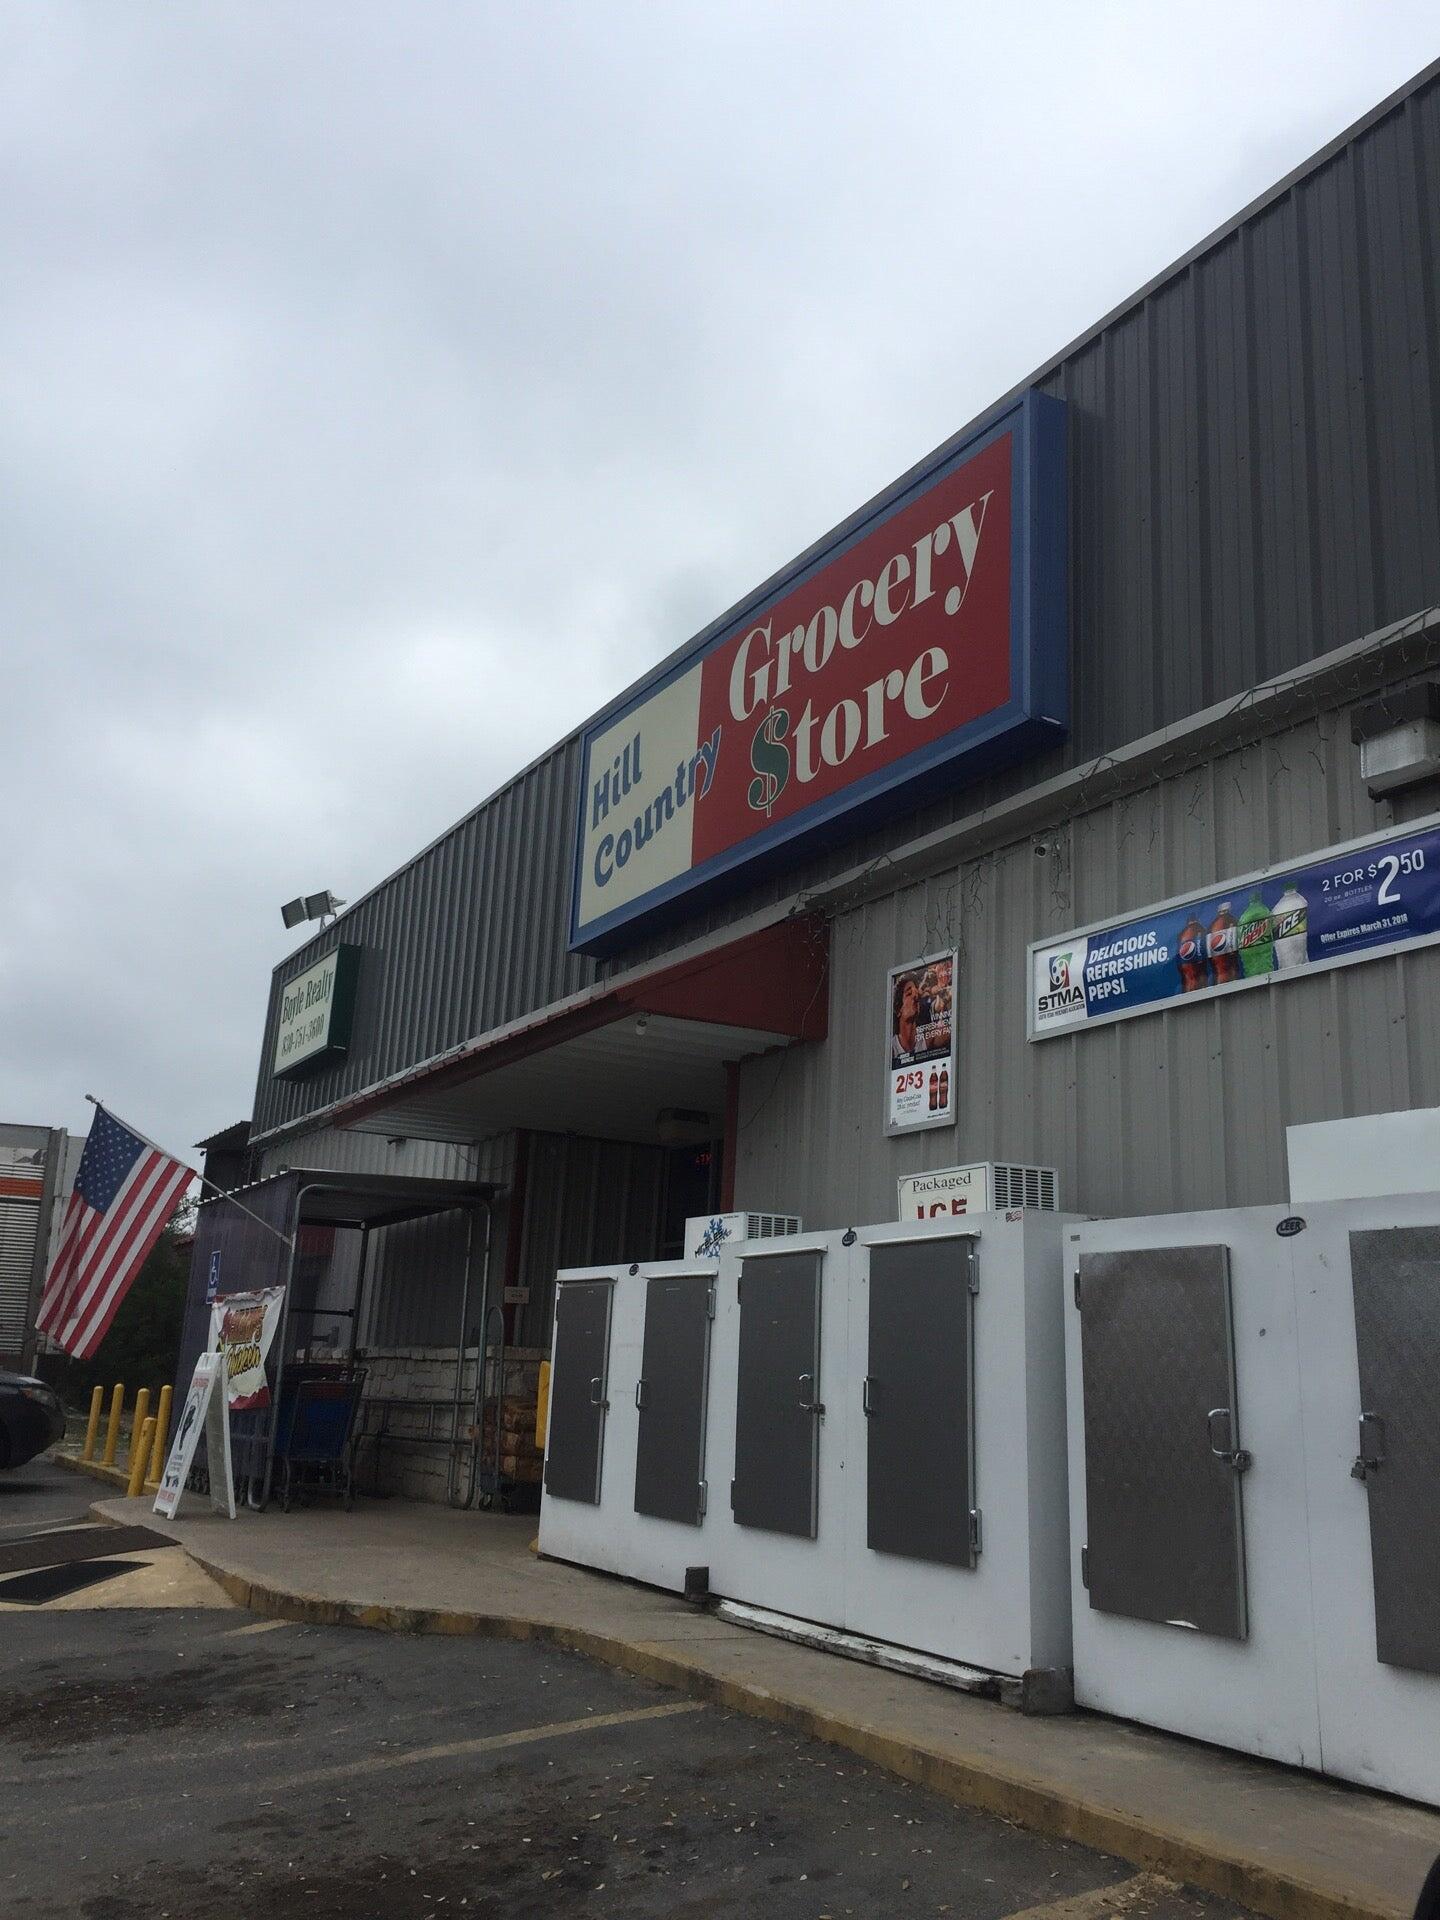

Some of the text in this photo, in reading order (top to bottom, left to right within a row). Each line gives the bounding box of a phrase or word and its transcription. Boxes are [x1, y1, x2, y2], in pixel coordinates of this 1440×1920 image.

[729, 490, 994, 721] Grocery
[592, 731, 642, 831] Hill
[594, 725, 722, 887] Country
[1322, 880, 1330, 891] 2
[1334, 868, 1364, 888] FOR
[1088, 931, 1158, 965] DELICIOUS.
[1320, 933, 1336, 943] Offer
[1337, 927, 1360, 939] Expires
[1360, 920, 1382, 933] March
[1086, 946, 1170, 983] REFRESHING.
[282, 970, 334, 1025] Boyle Realty
[1038, 986, 1084, 1012] STMA
[1088, 977, 1128, 1002] PEPSI.
[912, 1172, 972, 1193] Packaged
